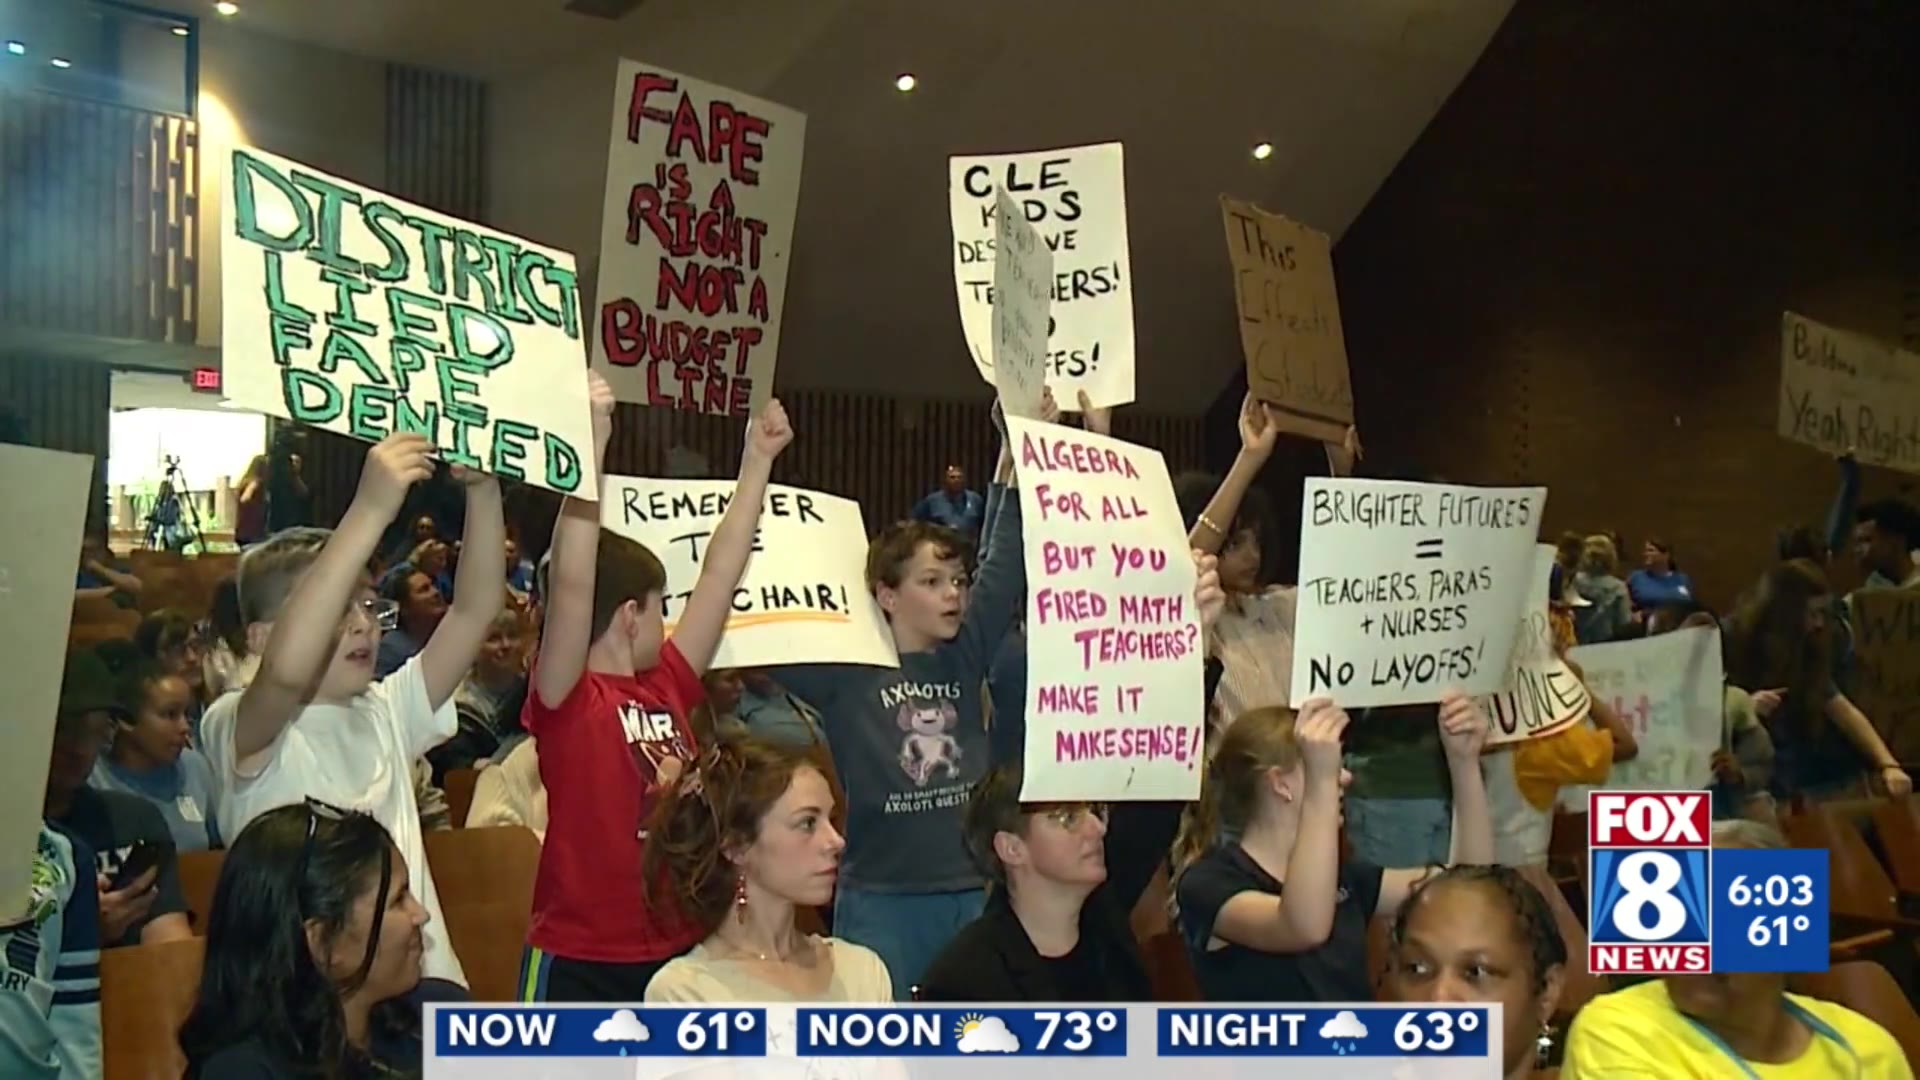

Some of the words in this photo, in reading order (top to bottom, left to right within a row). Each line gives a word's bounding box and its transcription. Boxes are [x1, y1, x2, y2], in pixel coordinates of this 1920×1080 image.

[627, 72, 769, 185] FAPE
[655, 163, 692, 201] IS
[709, 178, 734, 216] A
[964, 158, 1071, 197] CLE
[626, 183, 767, 270] RIGHT
[981, 190, 1082, 227] KDS
[232, 150, 578, 338] DISTRICT
[958, 229, 1077, 263] DESVE
[1231, 211, 1296, 271] This
[656, 257, 745, 317] NOT
[748, 275, 769, 323] A
[964, 261, 1120, 305] TEERS!
[264, 250, 514, 368] LIED
[602, 297, 763, 377] BUDGET
[270, 310, 488, 415] FAPE
[646, 360, 752, 416] LINE
[281, 369, 582, 492] DENIED
[1022, 431, 1139, 480] ALGEBRA
[622, 487, 824, 525] REMEMER
[1036, 484, 1091, 521] FOR
[1102, 496, 1148, 521] ALL
[1312, 489, 1427, 529] BRIGHTER
[1439, 492, 1530, 529] FUTURES
[669, 529, 764, 563] TE
[1043, 541, 1096, 575] BUT
[1111, 542, 1166, 577] YOU
[731, 584, 850, 616] CHAIR!
[1036, 589, 1107, 625] FIRED
[1120, 595, 1183, 625] MATH
[1306, 572, 1420, 606] TEACHERS,
[1429, 566, 1492, 601] PARAS
[1381, 604, 1468, 639] NURSES
[1074, 623, 1198, 671] TEACHERS?
[1310, 654, 1355, 693] NO
[1371, 637, 1485, 690] LAYOFFS!
[1037, 686, 1099, 714] MAKE
[1116, 686, 1143, 713] IT
